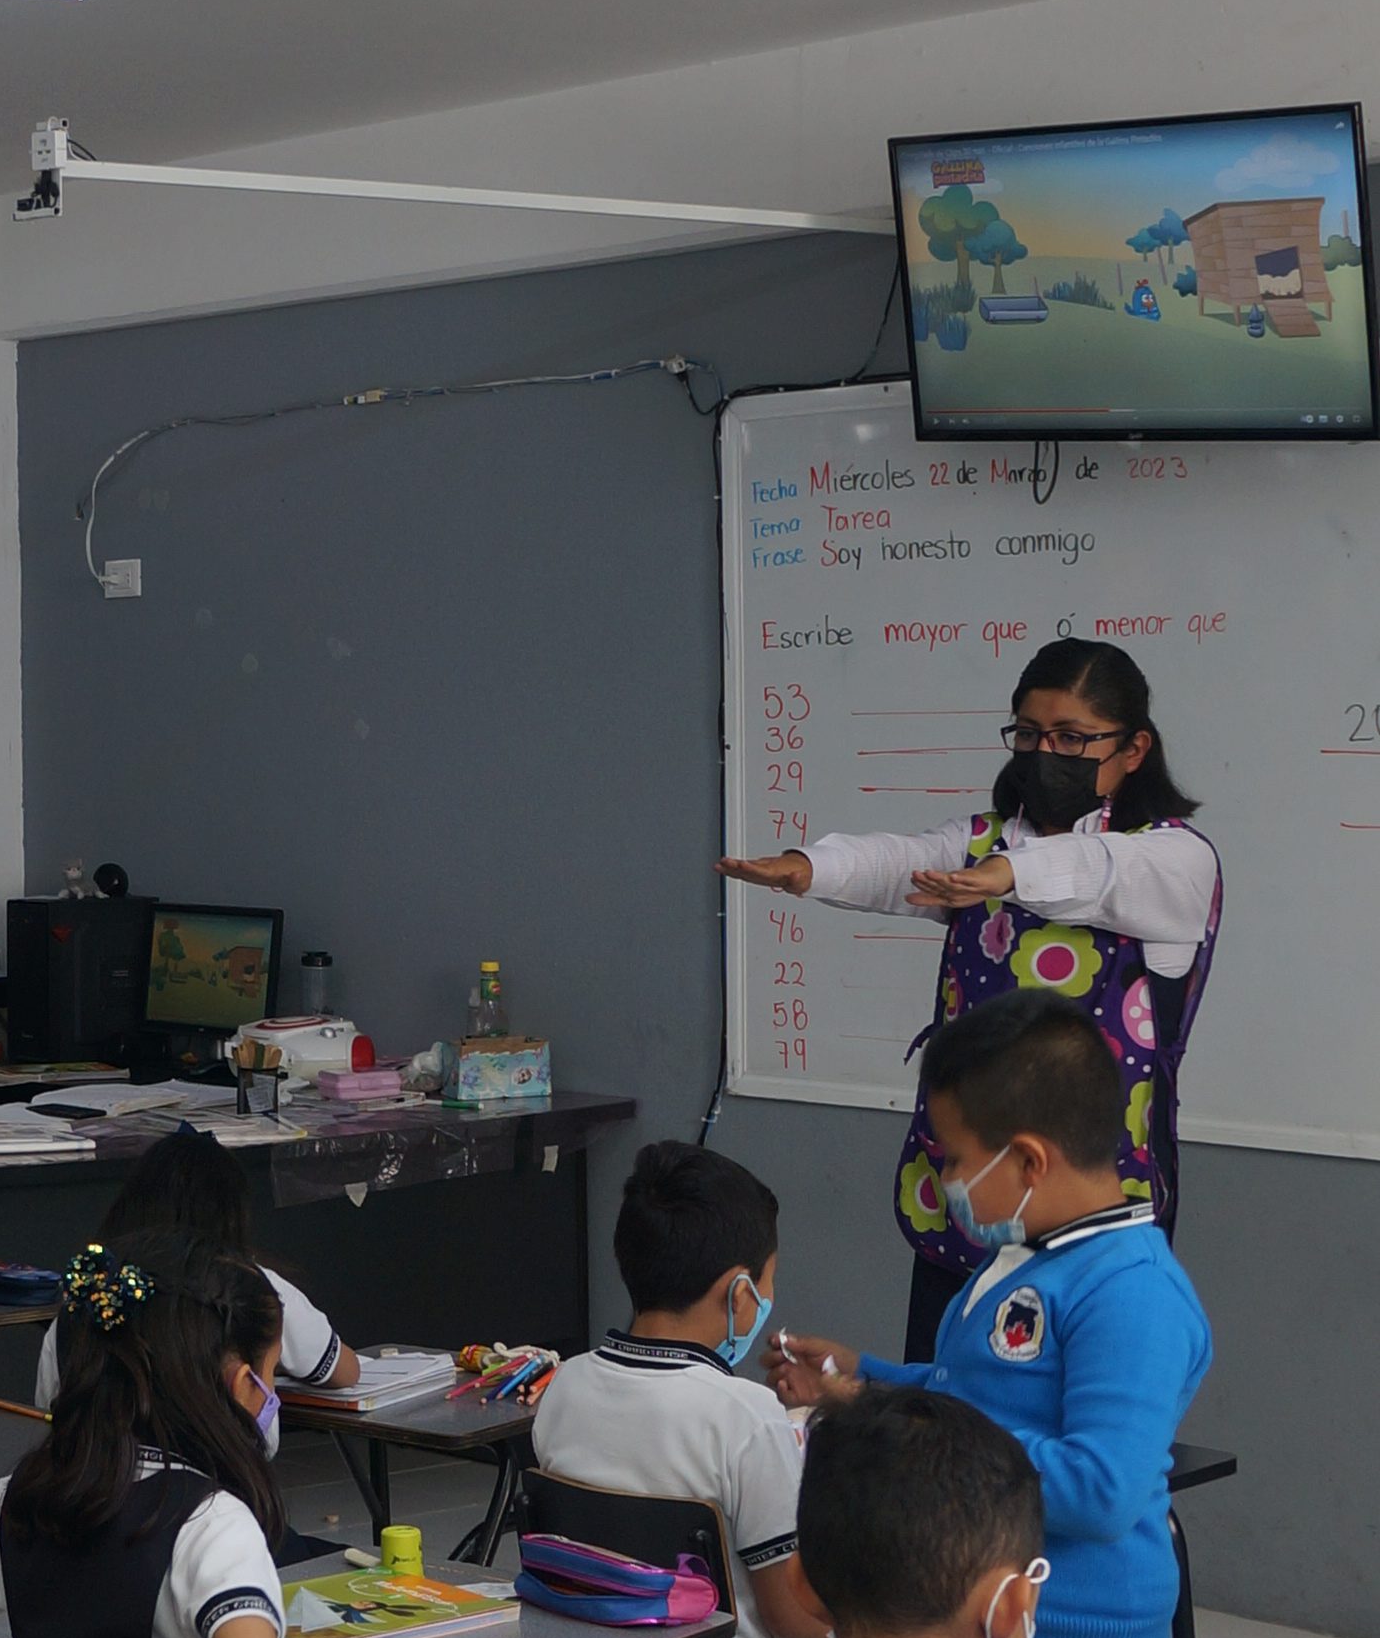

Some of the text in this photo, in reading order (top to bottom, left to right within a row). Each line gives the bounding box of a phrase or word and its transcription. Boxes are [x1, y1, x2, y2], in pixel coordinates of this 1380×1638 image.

[751, 479, 798, 504] Fecha
[809, 459, 917, 497] Miércoles
[929, 461, 951, 486] 22
[956, 459, 978, 484] de
[1075, 456, 1100, 479] de
[1127, 455, 1189, 479] 2023
[750, 505, 892, 540] Tema Tarea
[752, 528, 1095, 571] Frase Soy honesto conmigo
[762, 614, 855, 650] Escribe
[884, 620, 969, 653] mayor
[982, 621, 1028, 658] que
[1095, 614, 1173, 638] menor
[1187, 611, 1227, 644] que
[763, 683, 812, 722] 53
[764, 724, 805, 753] 36
[767, 760, 804, 793] 29
[769, 809, 808, 846] 74
[769, 910, 805, 945] 46
[773, 961, 807, 987] 22
[772, 998, 809, 1032] 58
[777, 1037, 809, 1072] 79
